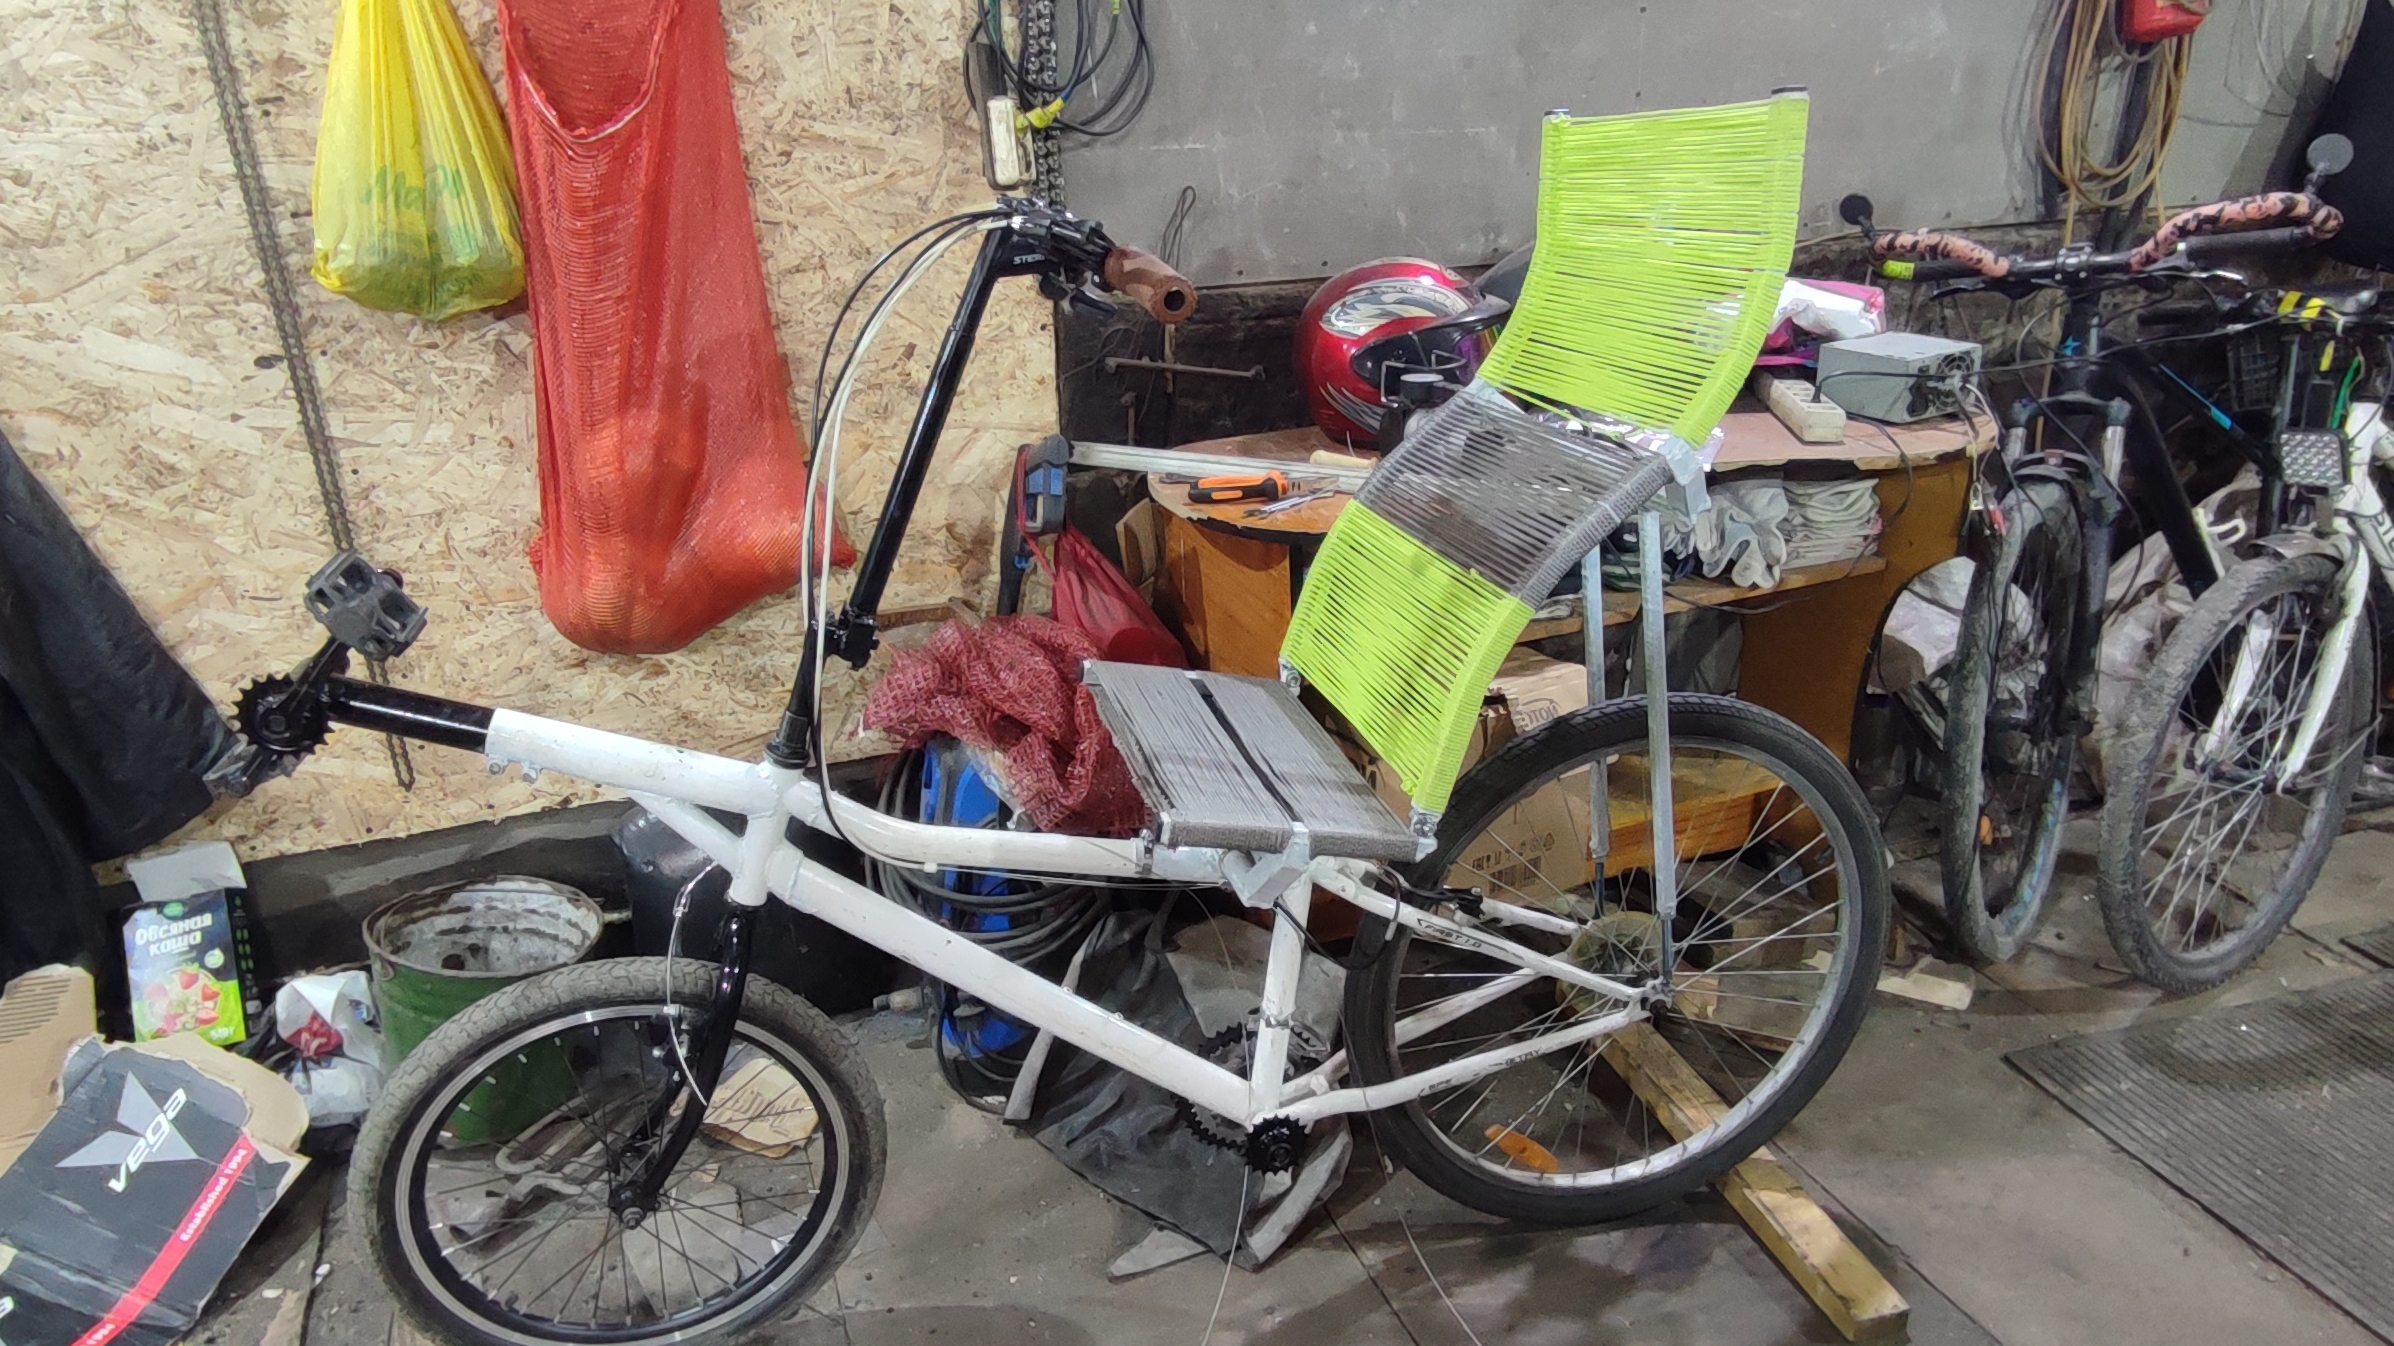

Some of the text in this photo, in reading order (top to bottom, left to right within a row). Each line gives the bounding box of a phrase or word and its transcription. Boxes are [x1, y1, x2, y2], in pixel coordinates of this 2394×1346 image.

[134, 912, 213, 946] Овсяная
[149, 930, 202, 957] каша
[107, 1087, 188, 1193] vega
[179, 1148, 248, 1243] Established 1994
